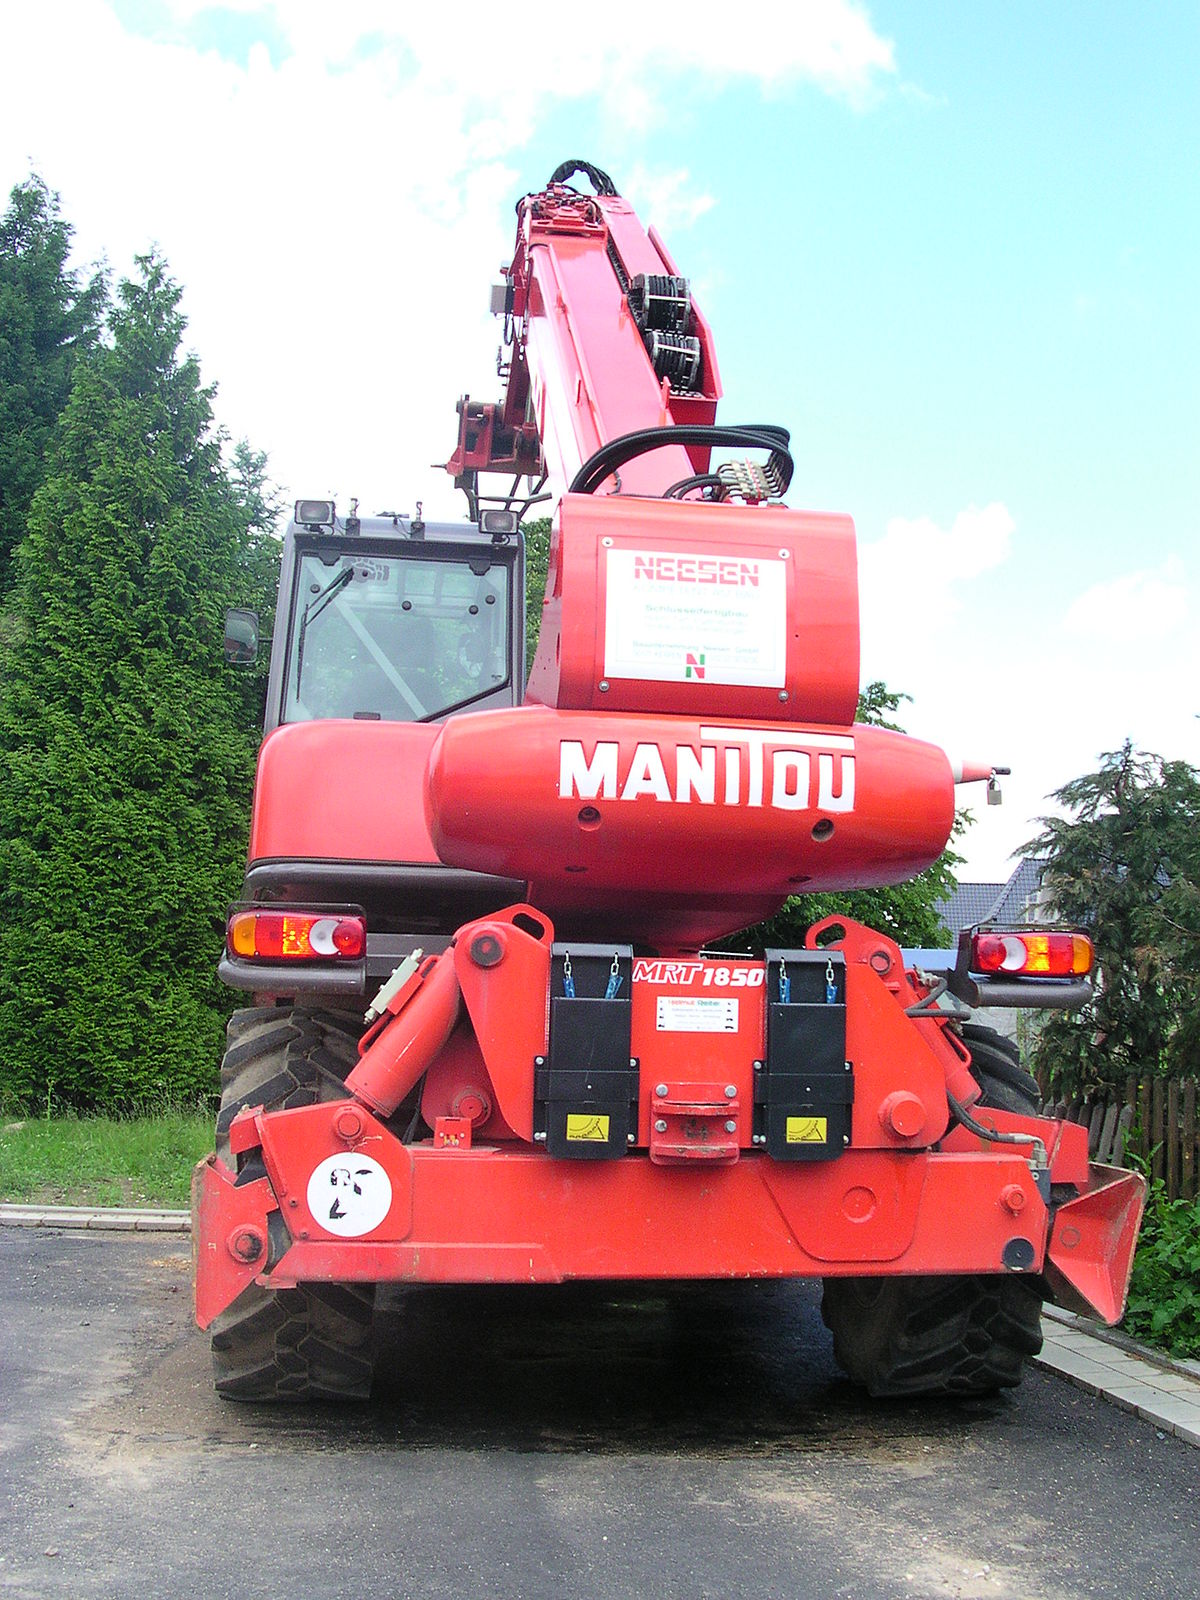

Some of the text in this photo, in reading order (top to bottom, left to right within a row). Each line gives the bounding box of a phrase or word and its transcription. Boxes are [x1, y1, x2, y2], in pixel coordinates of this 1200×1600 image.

[634, 556, 759, 587] NEESEN
[558, 725, 856, 812] MANITOU
[632, 961, 765, 987] MRT 1850
